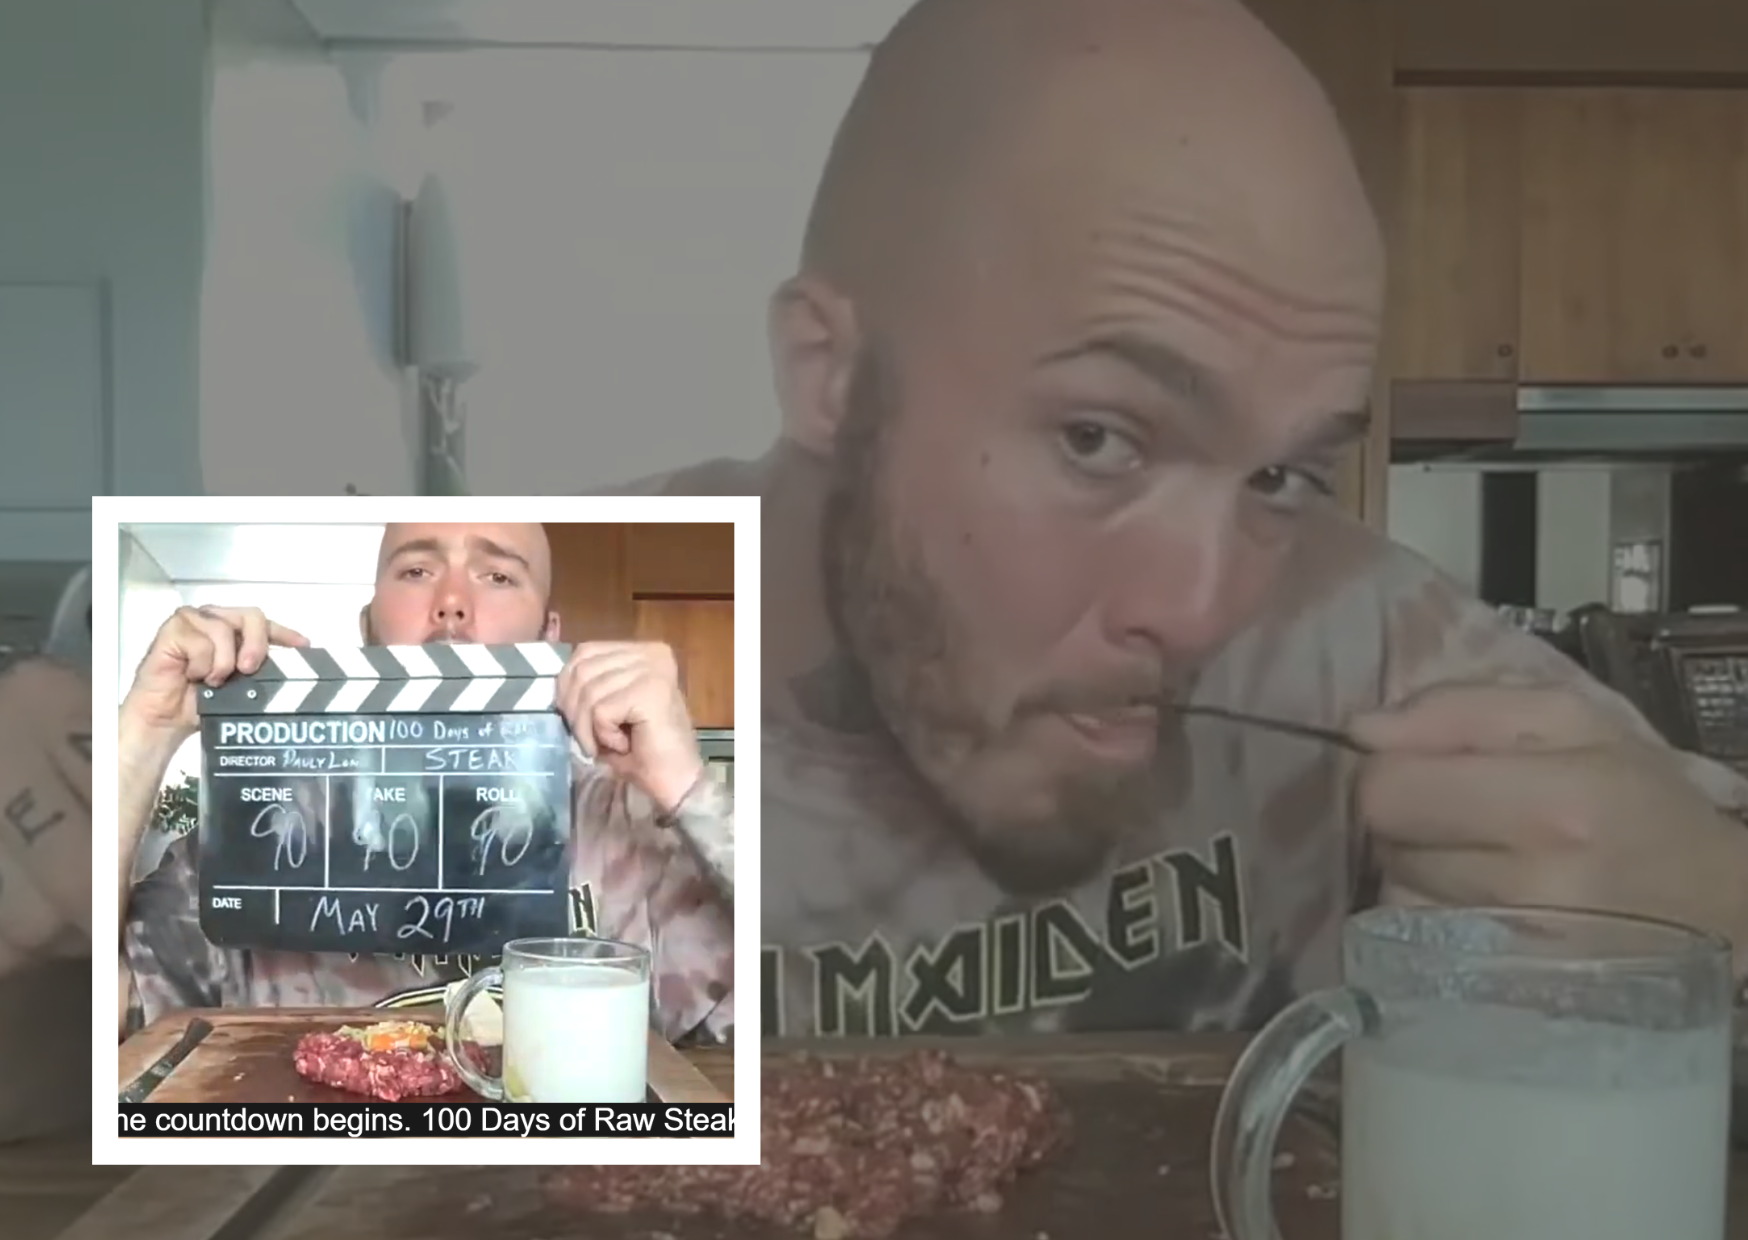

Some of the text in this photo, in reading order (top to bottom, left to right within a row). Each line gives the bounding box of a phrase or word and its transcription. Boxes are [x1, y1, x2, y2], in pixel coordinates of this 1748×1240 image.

[220, 720, 385, 744] PRODUCTION
[389, 720, 424, 740] 100
[219, 756, 276, 767] DIRECTOR
[425, 748, 516, 770] STEAK
[240, 787, 293, 802] SCENE
[364, 787, 406, 802] AKE
[476, 787, 518, 802] ROLL
[251, 803, 307, 872] 90
[471, 805, 534, 876] 90
[212, 897, 242, 909] DATE
[310, 896, 380, 936] MAY
[803, 830, 1249, 1038] MAIDEN
